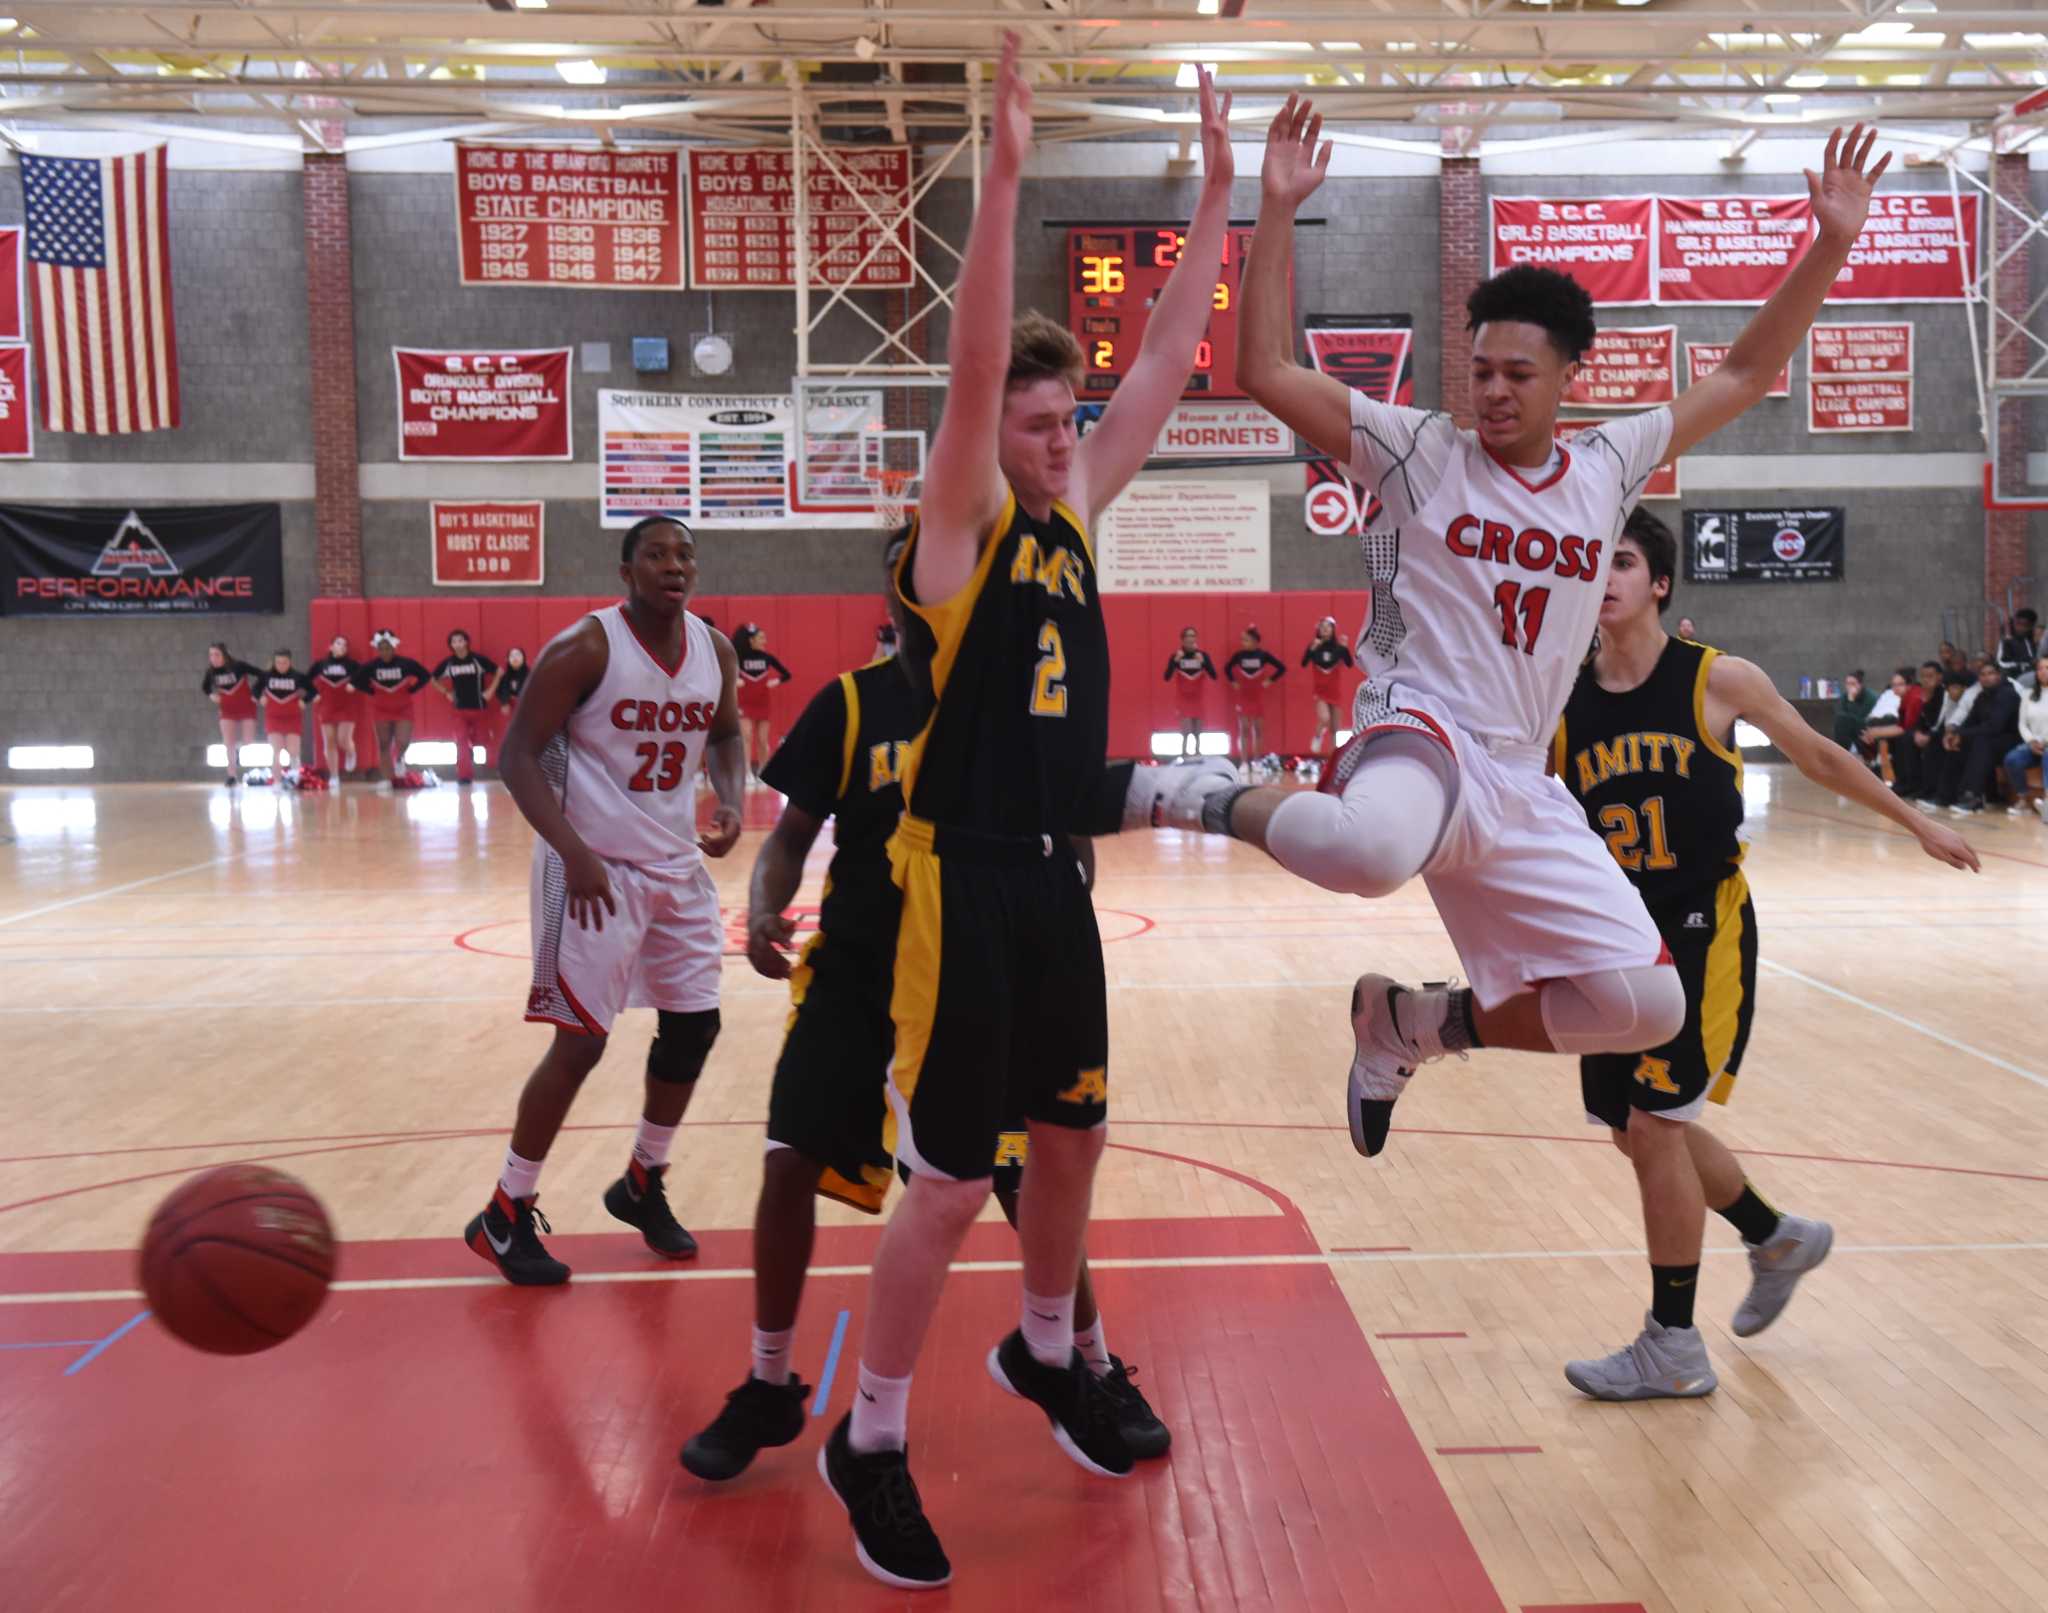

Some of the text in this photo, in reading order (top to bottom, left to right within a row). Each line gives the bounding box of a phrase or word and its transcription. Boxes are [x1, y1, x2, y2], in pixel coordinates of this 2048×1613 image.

[467, 151, 497, 168] HOME
[503, 152, 517, 169] OF
[524, 153, 547, 169] THE
[467, 173, 669, 195] BOYS BASKETBALL
[699, 175, 752, 192] BOYS
[475, 195, 664, 221] STATE CHAMPIONS
[480, 223, 661, 244] 1927 1930 1936
[1498, 223, 1647, 242] GIRLS BASKETBALL
[1676, 235, 1795, 250] GIRLS BASKETBALL
[480, 243, 528, 260] 1937
[613, 246, 662, 263] 1942
[1510, 244, 1634, 263] CHAMPIONS
[1684, 251, 1787, 266] CHAMPIONS
[1847, 249, 1947, 265] CHAMPIONS
[481, 261, 529, 279] 1945
[614, 263, 662, 282] 1947
[1082, 256, 1125, 293] 36
[1095, 341, 1113, 368] 2
[1599, 367, 1669, 382] CHAMPIONS
[410, 389, 560, 404] BOYS BASKETBALL
[611, 394, 682, 408] SOUTHERN
[688, 395, 778, 408] CONNECTICUT
[430, 406, 538, 421] CHAMPIONS
[1178, 412, 1269, 422] Home of the
[1167, 427, 1280, 446] HORNETS
[472, 512, 535, 528] BASKETBALL
[486, 534, 530, 551] CLASSIC
[1446, 513, 1603, 582] CROSS
[17, 576, 253, 597] PERFORMANCE
[1494, 579, 1551, 656] 11
[1029, 618, 1068, 718] 2
[610, 699, 714, 732] CROSS
[628, 741, 687, 792] 23
[1575, 731, 1696, 796] AMITY
[1598, 796, 1678, 872] 21
[1633, 1053, 1681, 1095] A
[1056, 1065, 1107, 1105] A
[994, 1131, 1029, 1166] A
